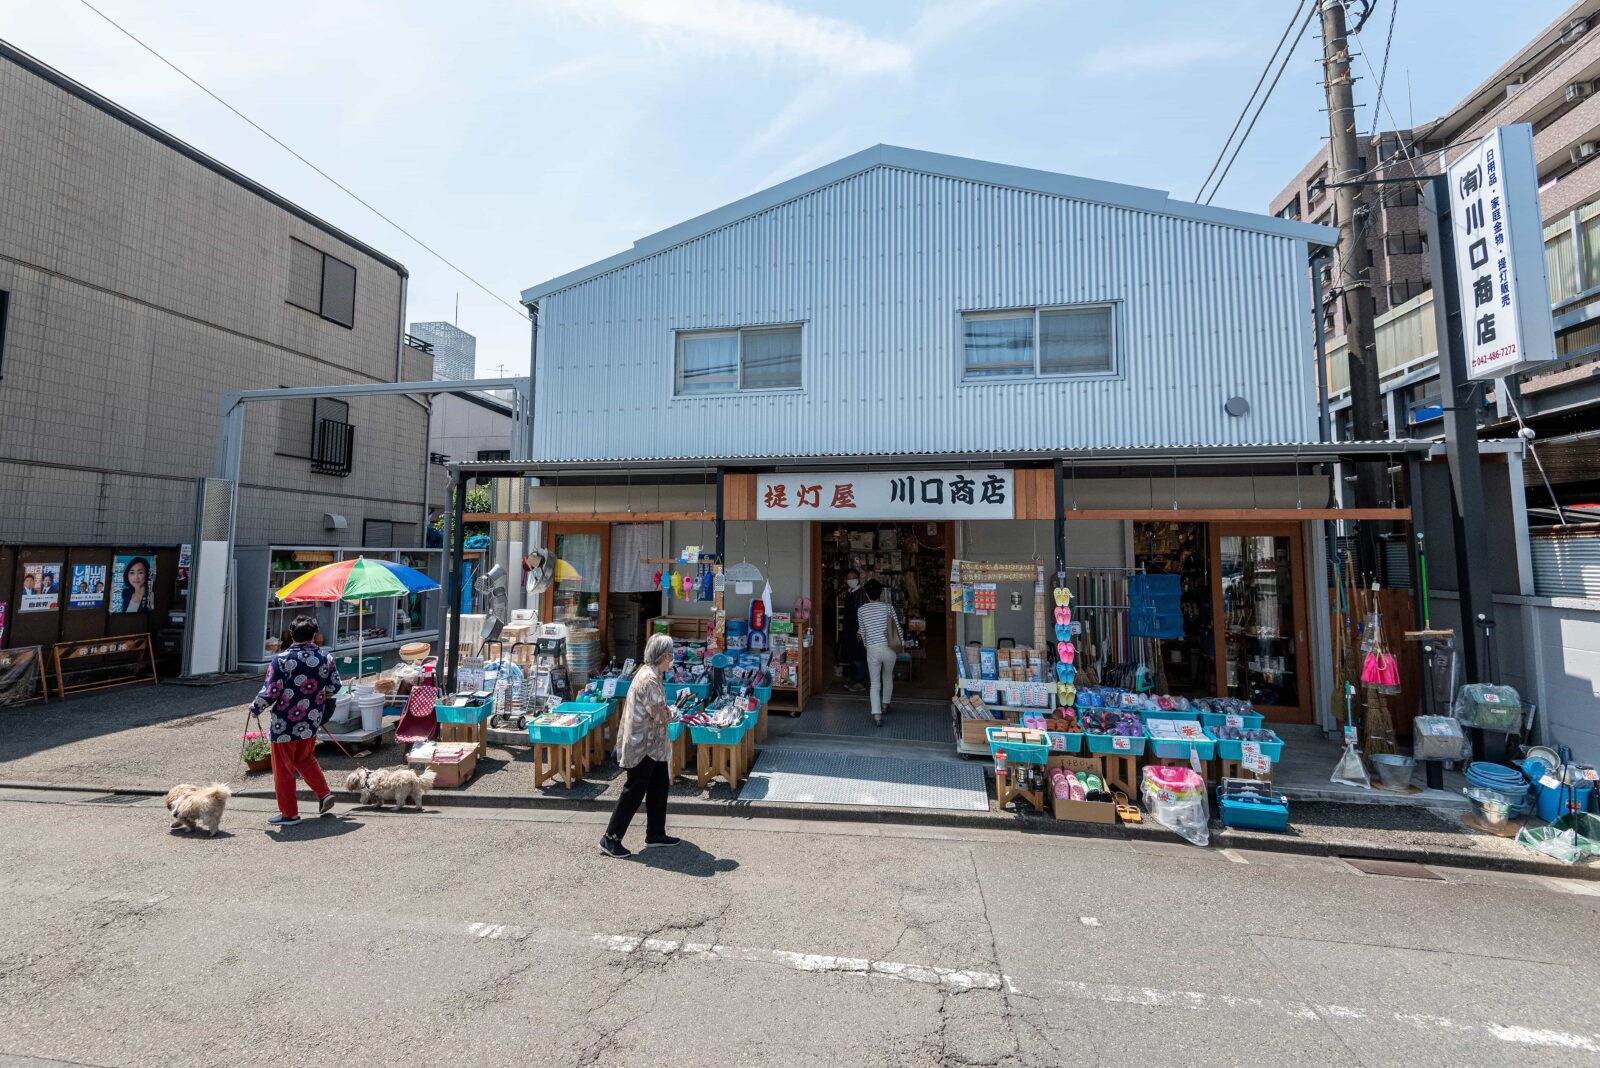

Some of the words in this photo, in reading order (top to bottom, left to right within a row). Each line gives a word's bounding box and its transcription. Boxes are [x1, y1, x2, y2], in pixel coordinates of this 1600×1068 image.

[1486, 149, 1511, 308] 日用品・家庭金物・提灯販売
[1476, 344, 1517, 366] 042-486-7272
[763, 483, 857, 509] 提灯屋
[890, 475, 1006, 505] 川口商店
